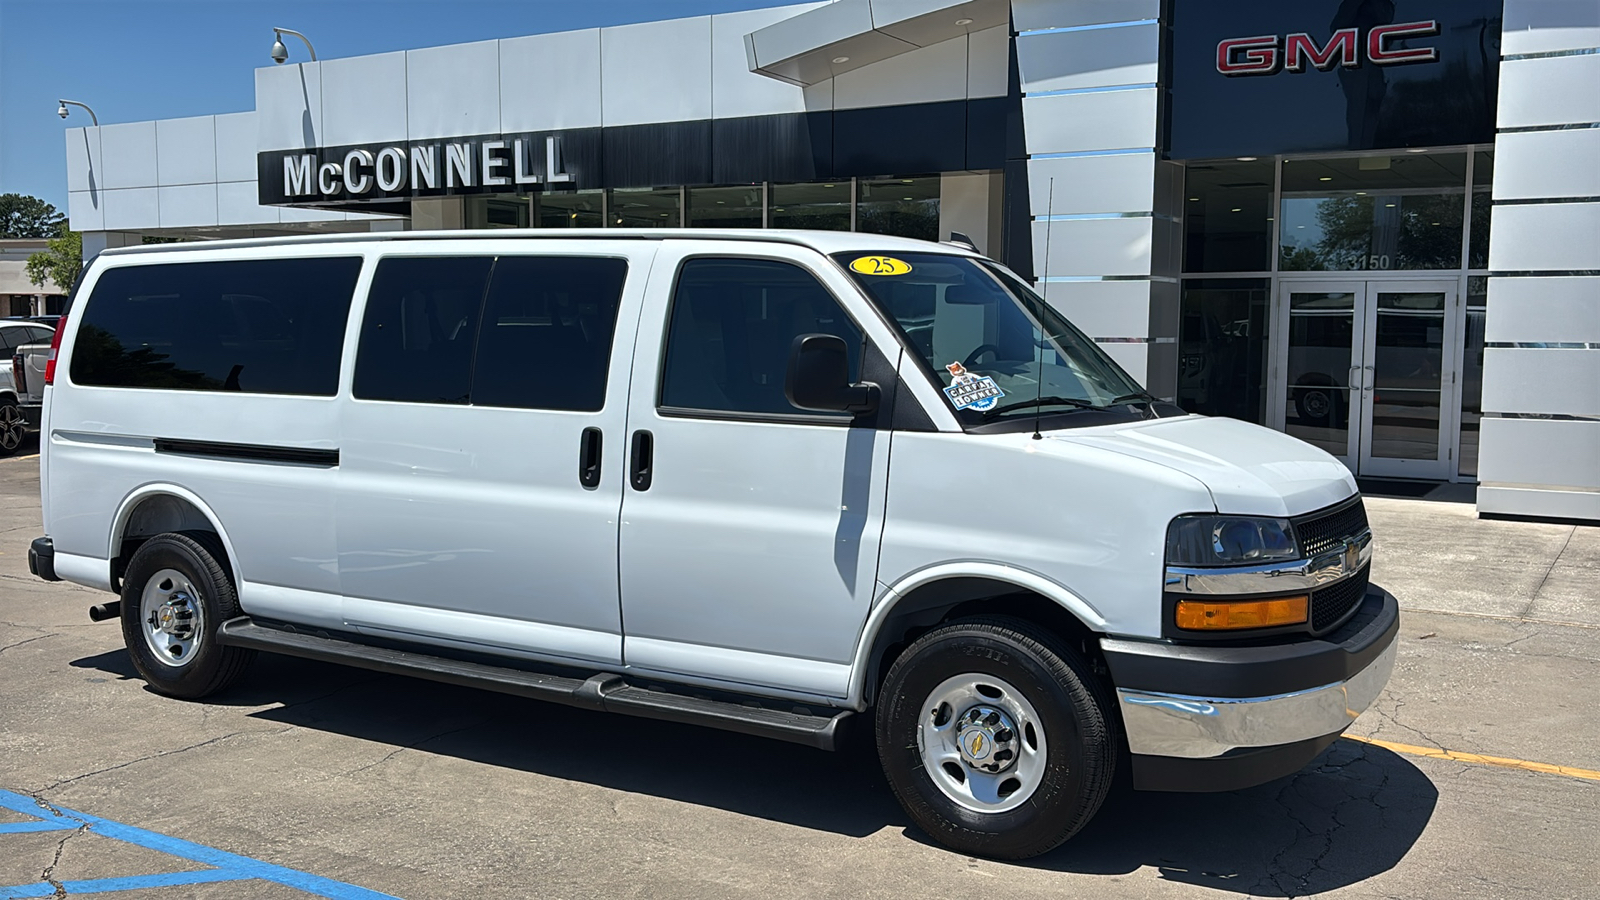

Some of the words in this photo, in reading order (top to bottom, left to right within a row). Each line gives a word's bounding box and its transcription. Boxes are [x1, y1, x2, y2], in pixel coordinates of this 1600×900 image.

[1216, 20, 1438, 75] GMC
[283, 136, 574, 196] McCONNELL
[869, 258, 895, 273] 25
[1349, 254, 1390, 270] 3150
[949, 381, 994, 398] CARFAX
[956, 398, 964, 406] 1
[963, 388, 999, 403] OWNER
